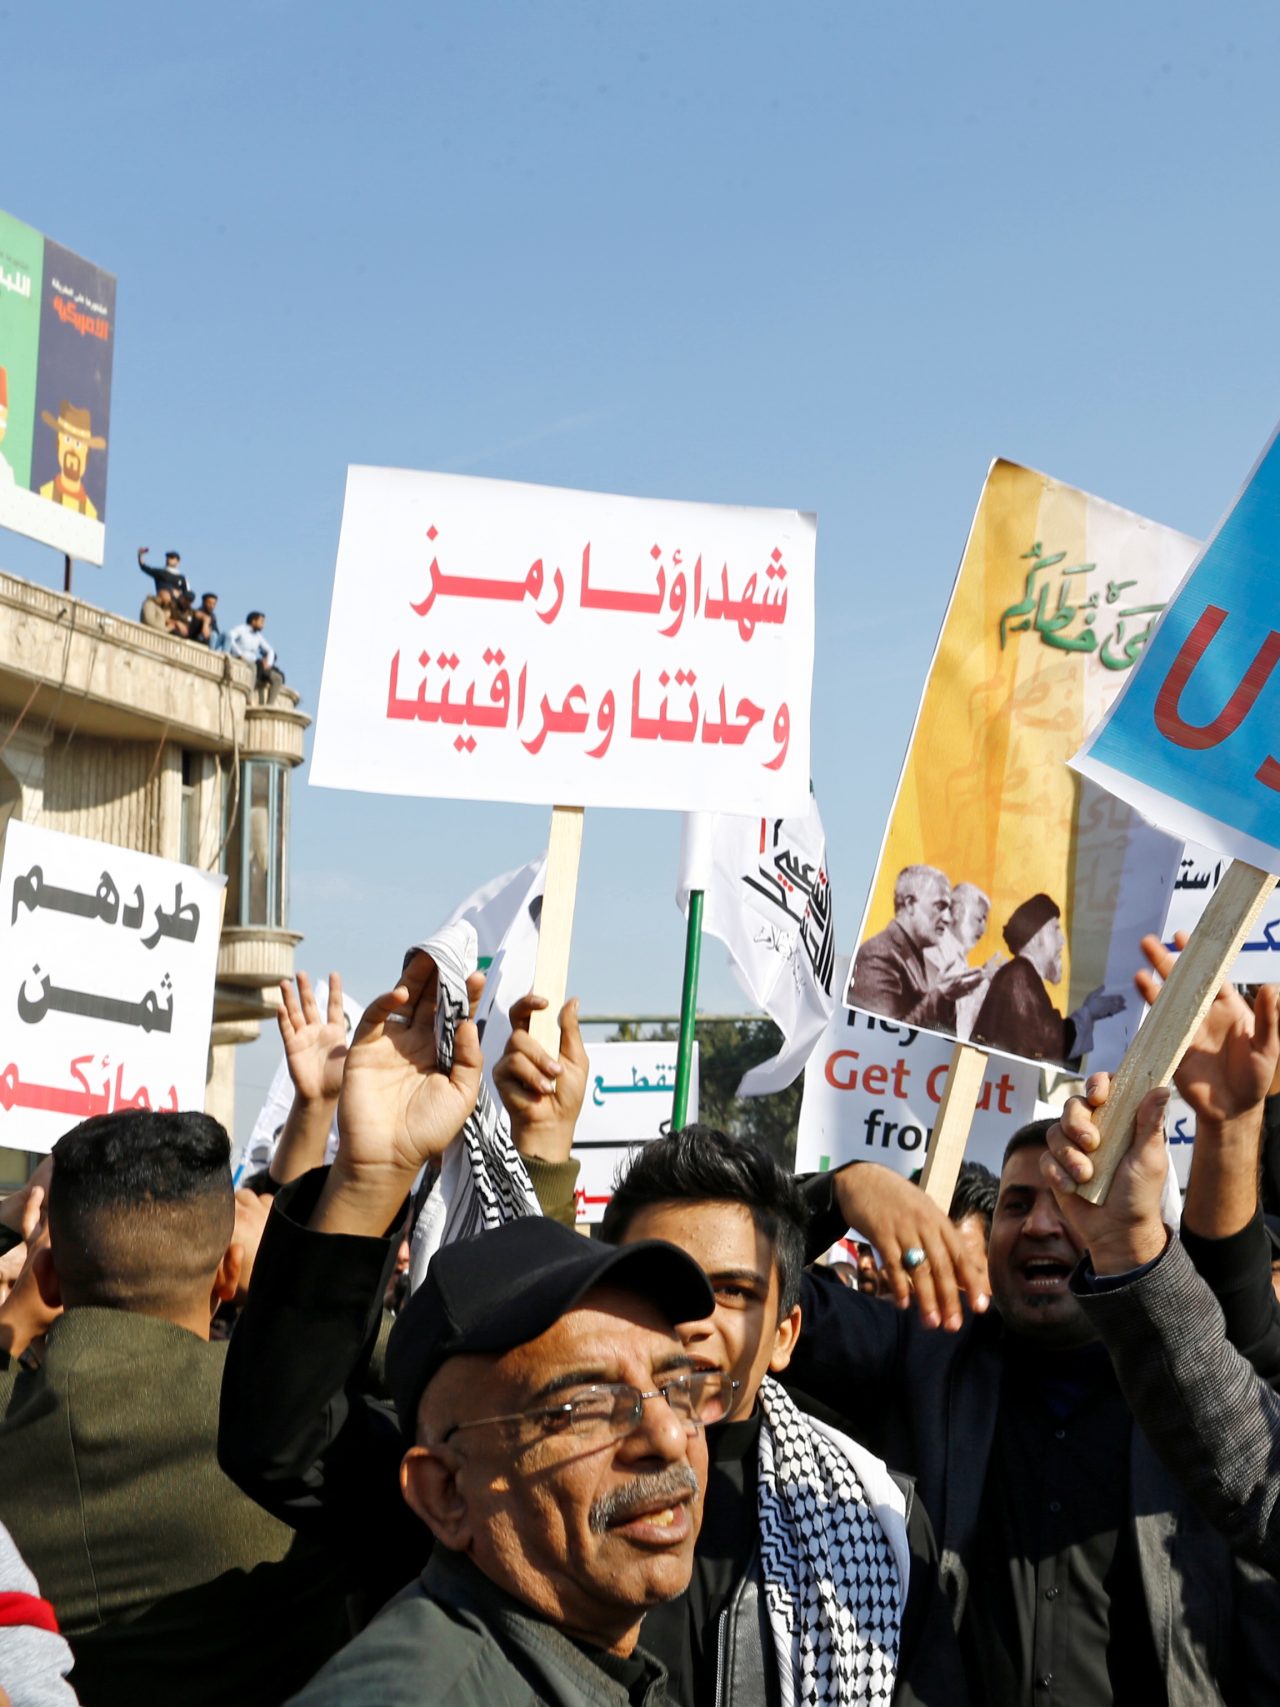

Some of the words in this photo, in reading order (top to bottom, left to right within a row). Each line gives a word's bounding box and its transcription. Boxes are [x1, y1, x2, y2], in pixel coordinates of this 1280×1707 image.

[409, 524, 565, 626] رمز
[580, 541, 788, 643] شهداؤنا
[386, 648, 616, 759] وعراقيتنا
[630, 668, 791, 771] وحدتنا
[11, 864, 200, 950] طردهم
[17, 963, 174, 1034] ثمن
[824, 1049, 911, 1100] Get
[864, 1109, 933, 1154] fro
